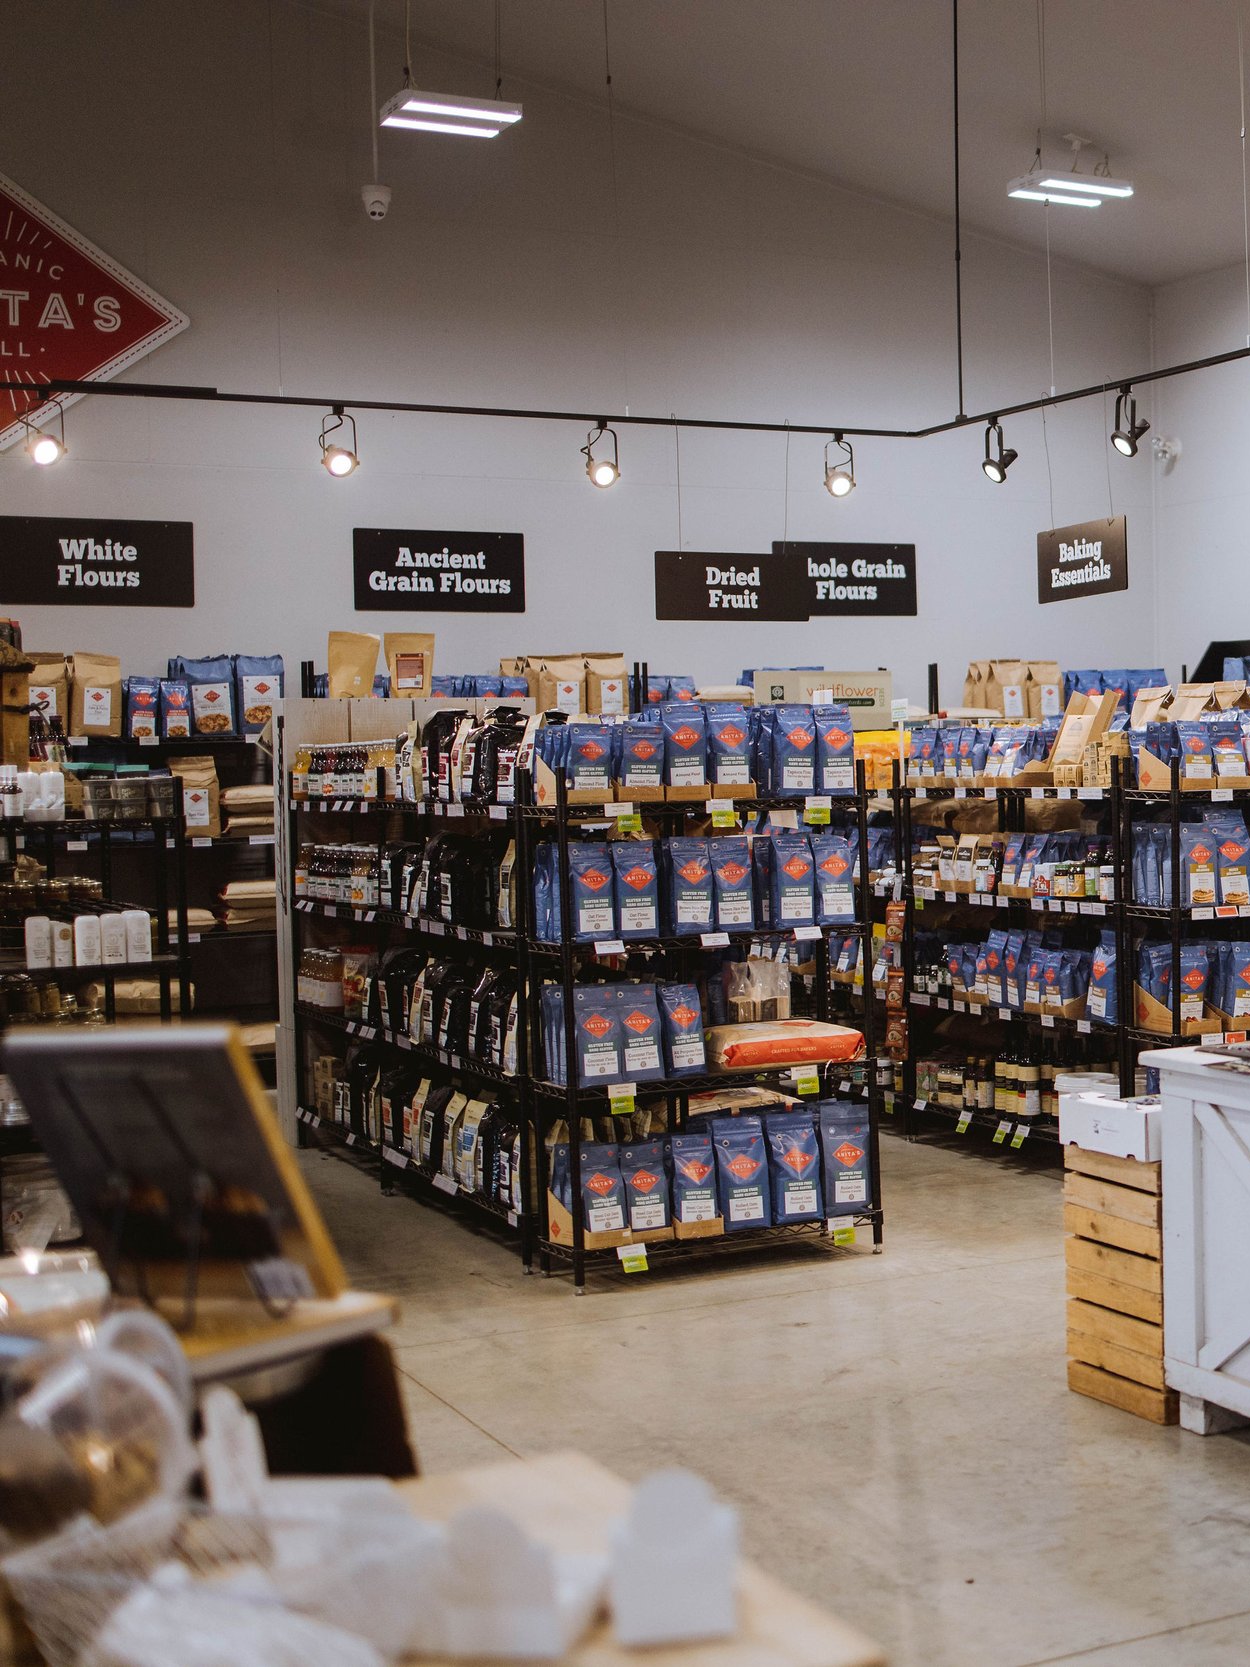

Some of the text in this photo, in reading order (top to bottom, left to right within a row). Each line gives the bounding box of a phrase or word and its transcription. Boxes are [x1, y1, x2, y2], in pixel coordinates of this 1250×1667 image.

[59, 538, 138, 562] White
[395, 547, 486, 570] Ancient
[1058, 538, 1102, 563] Baking
[57, 565, 140, 587] Flours
[705, 566, 761, 587] Dried
[807, 557, 907, 579] hole Grain
[1050, 560, 1112, 588] Essentials
[368, 571, 511, 595] Grain Flours
[816, 581, 878, 601] Flours
[708, 589, 759, 609] Fruit
